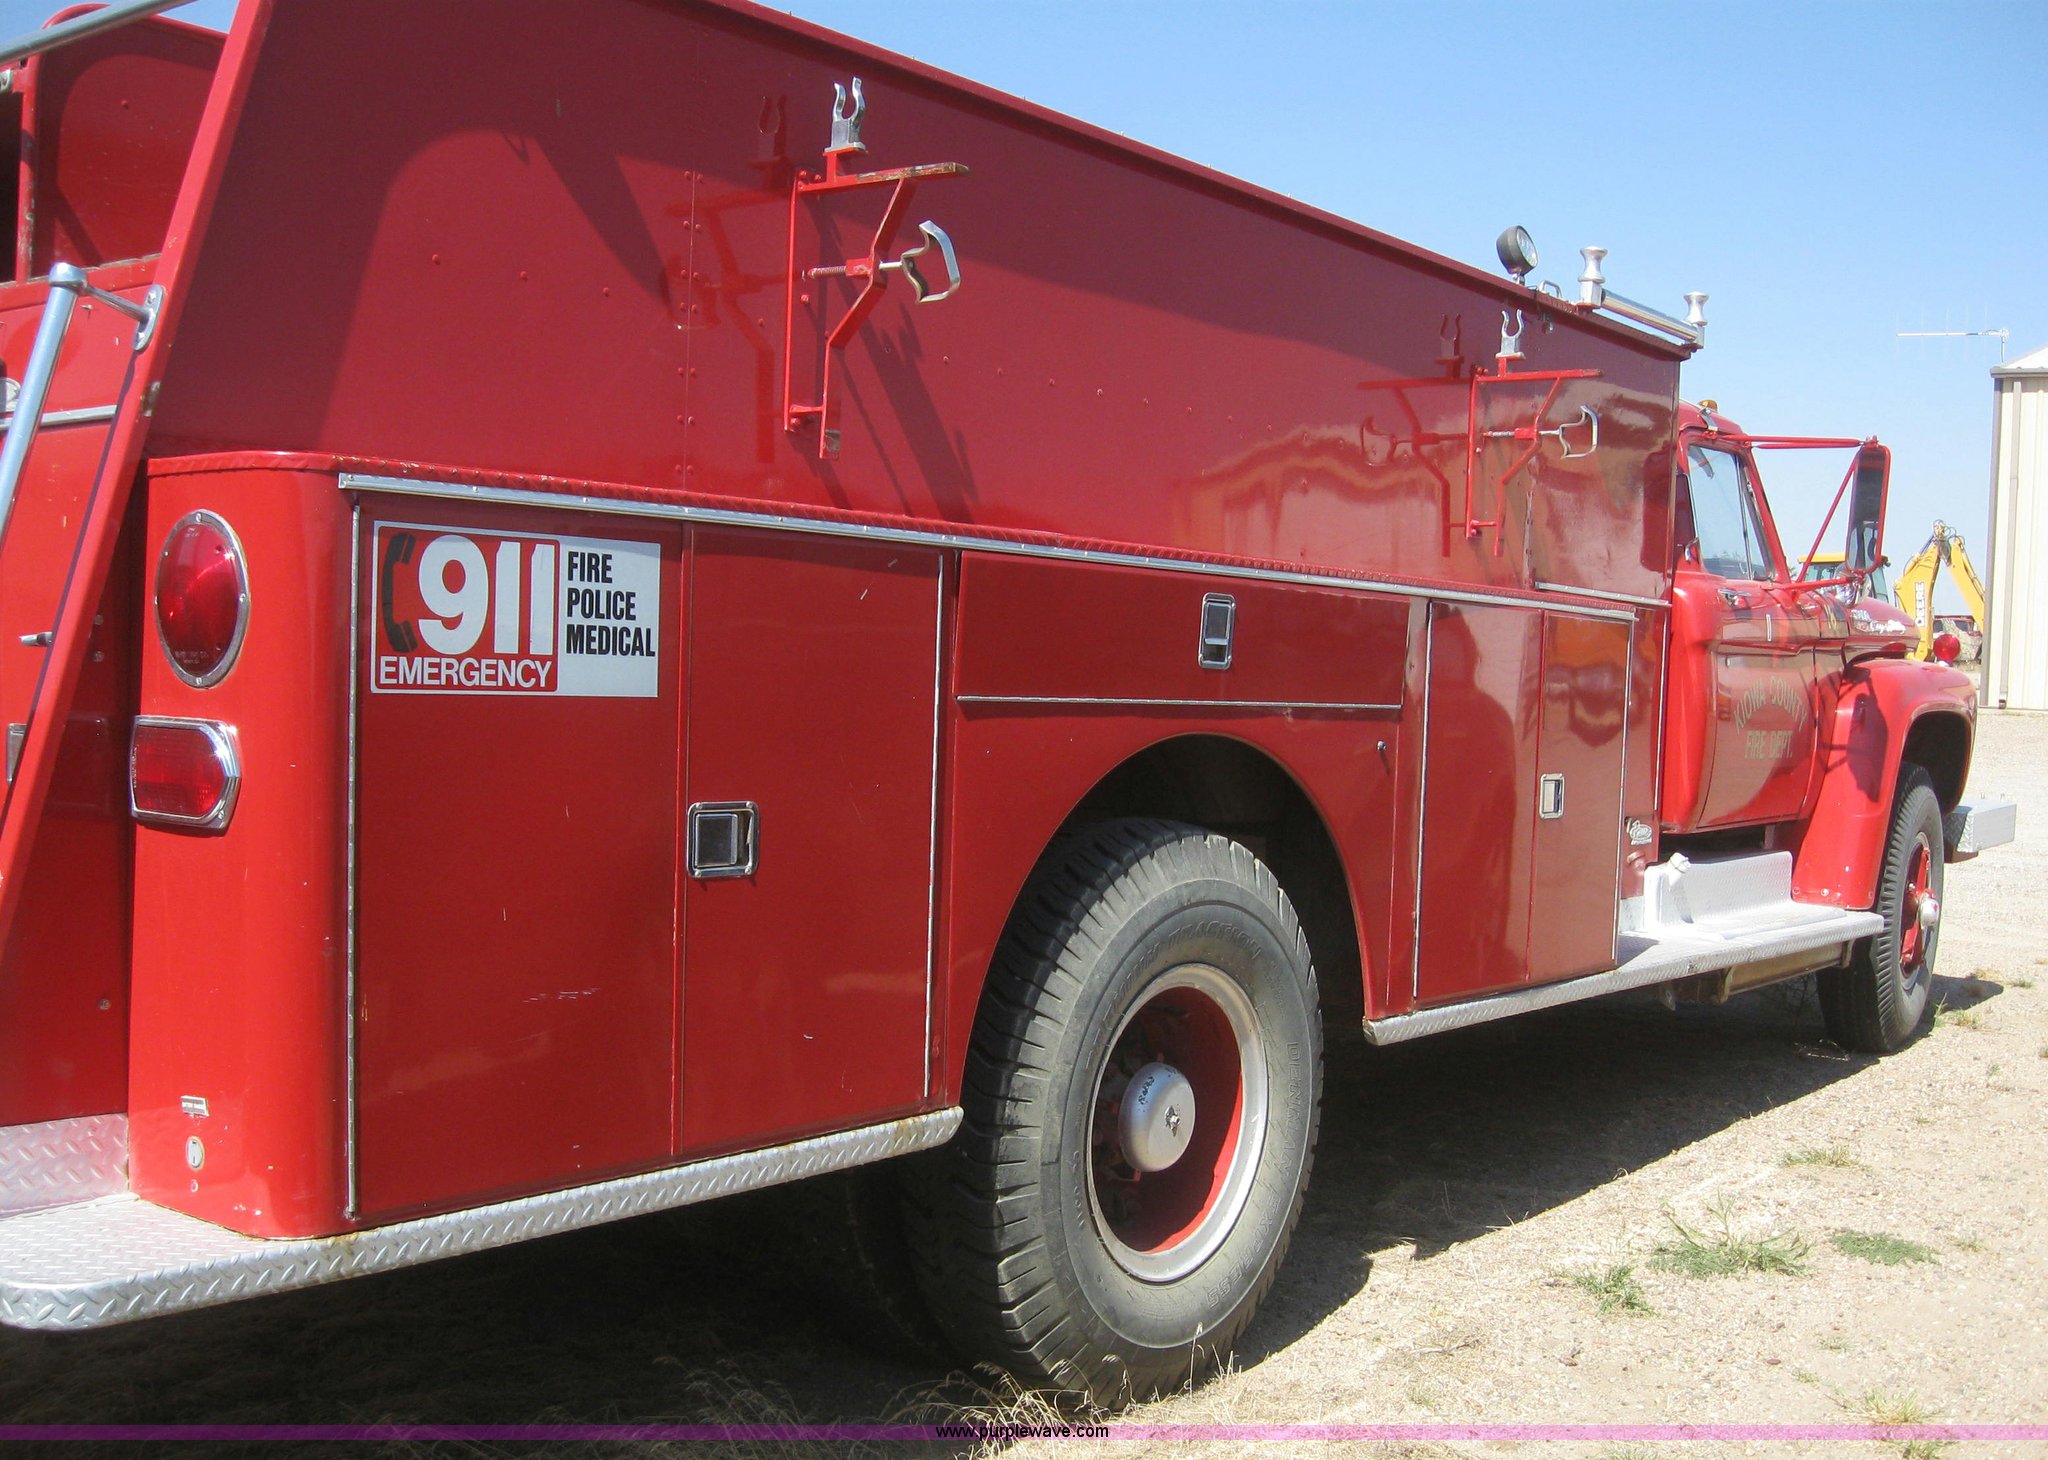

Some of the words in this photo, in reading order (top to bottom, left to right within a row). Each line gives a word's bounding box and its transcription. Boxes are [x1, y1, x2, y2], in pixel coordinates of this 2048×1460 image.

[567, 551, 613, 584] FIRE
[417, 534, 555, 656] 911
[566, 588, 637, 621] POLICE
[565, 623, 656, 657] MEDICAL
[379, 656, 553, 688] EMERGENCY
[1768, 675, 1808, 733] COUNTY
[1744, 730, 1767, 759] FIRE
